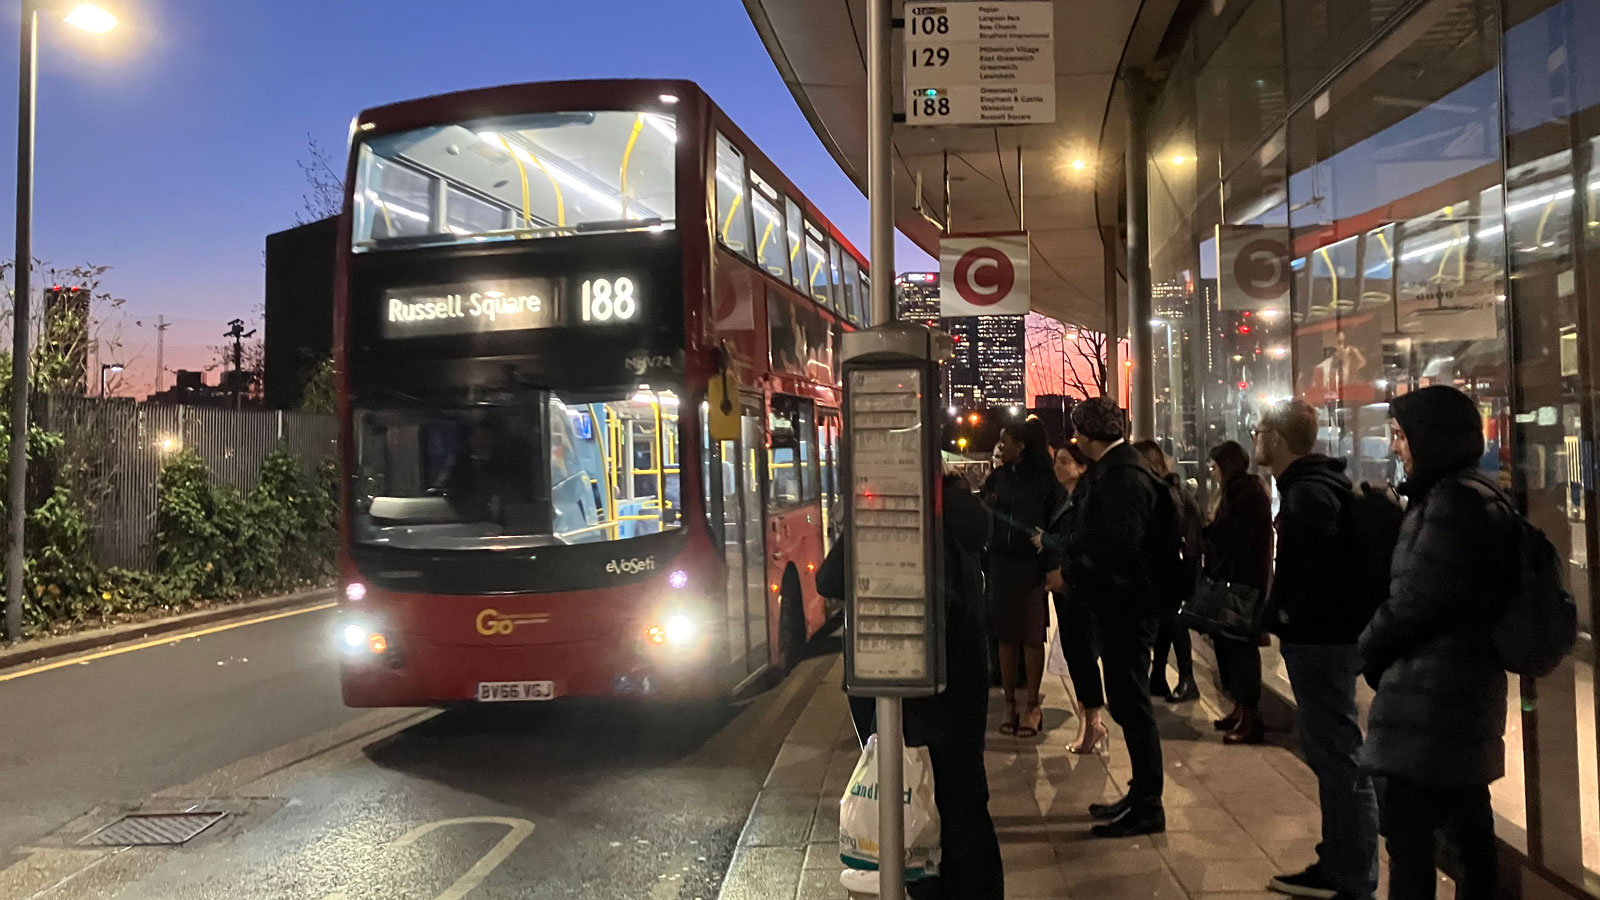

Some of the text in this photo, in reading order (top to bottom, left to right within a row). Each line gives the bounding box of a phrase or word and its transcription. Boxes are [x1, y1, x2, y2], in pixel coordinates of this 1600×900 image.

[912, 16, 949, 35] 108
[912, 48, 950, 67] 129
[913, 98, 950, 116] 188
[967, 257, 998, 295] C
[389, 291, 542, 322] Russell Square
[581, 277, 636, 322] 188
[476, 609, 514, 636] Go
